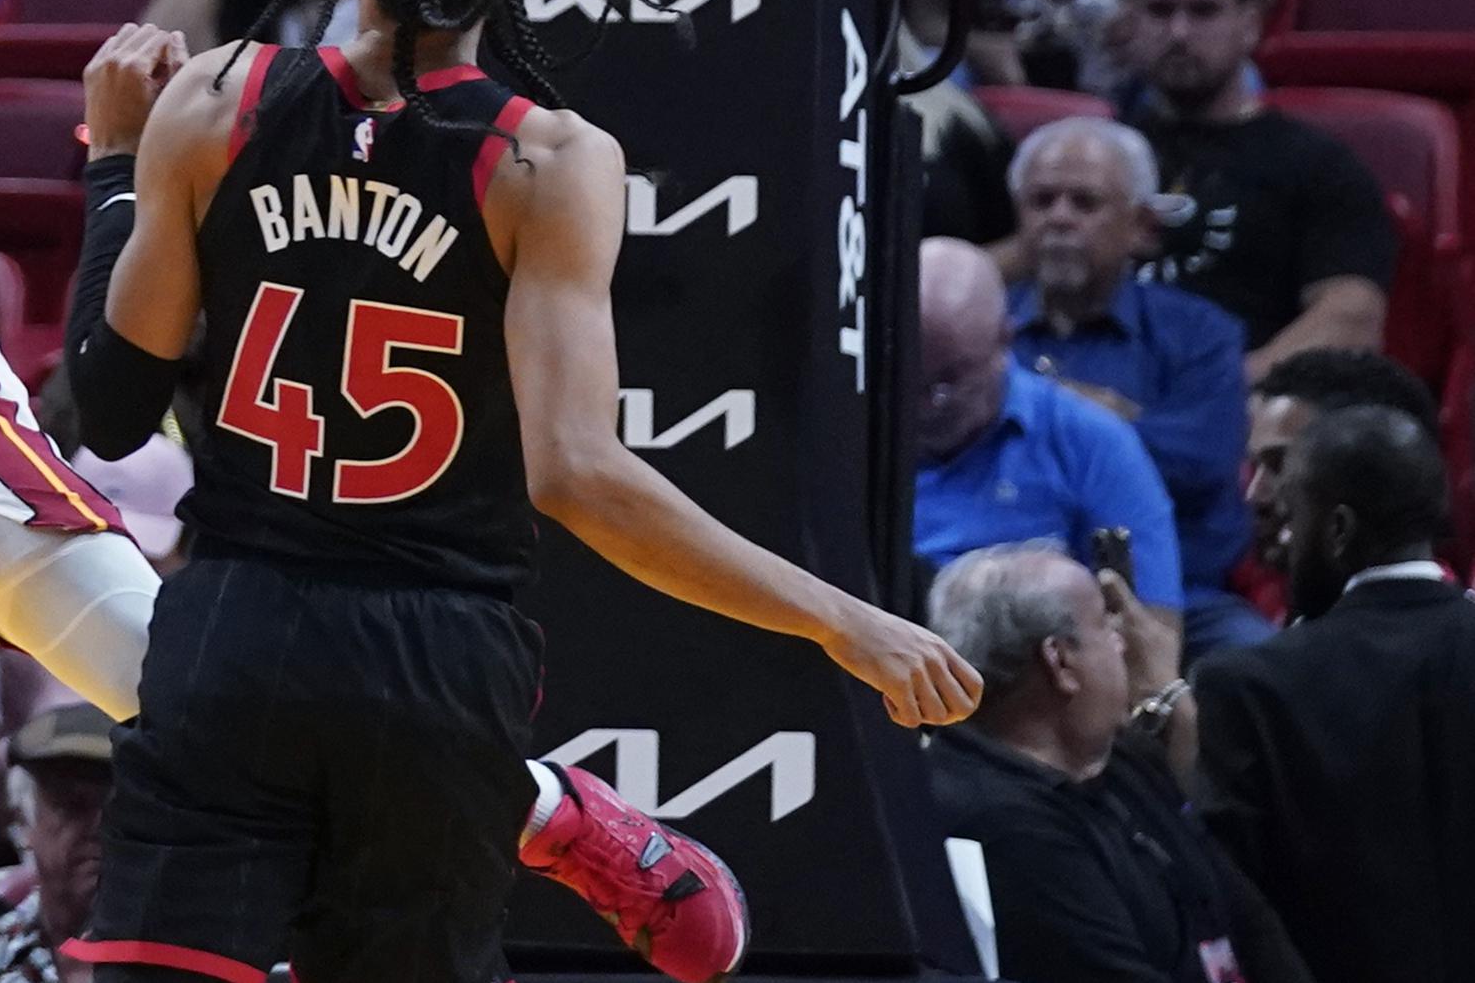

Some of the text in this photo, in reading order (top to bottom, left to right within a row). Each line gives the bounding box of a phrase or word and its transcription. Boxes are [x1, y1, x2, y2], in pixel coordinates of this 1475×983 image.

[249, 173, 459, 283] BANTON
[839, 8, 868, 395] AT&T
[215, 280, 464, 504] 45
